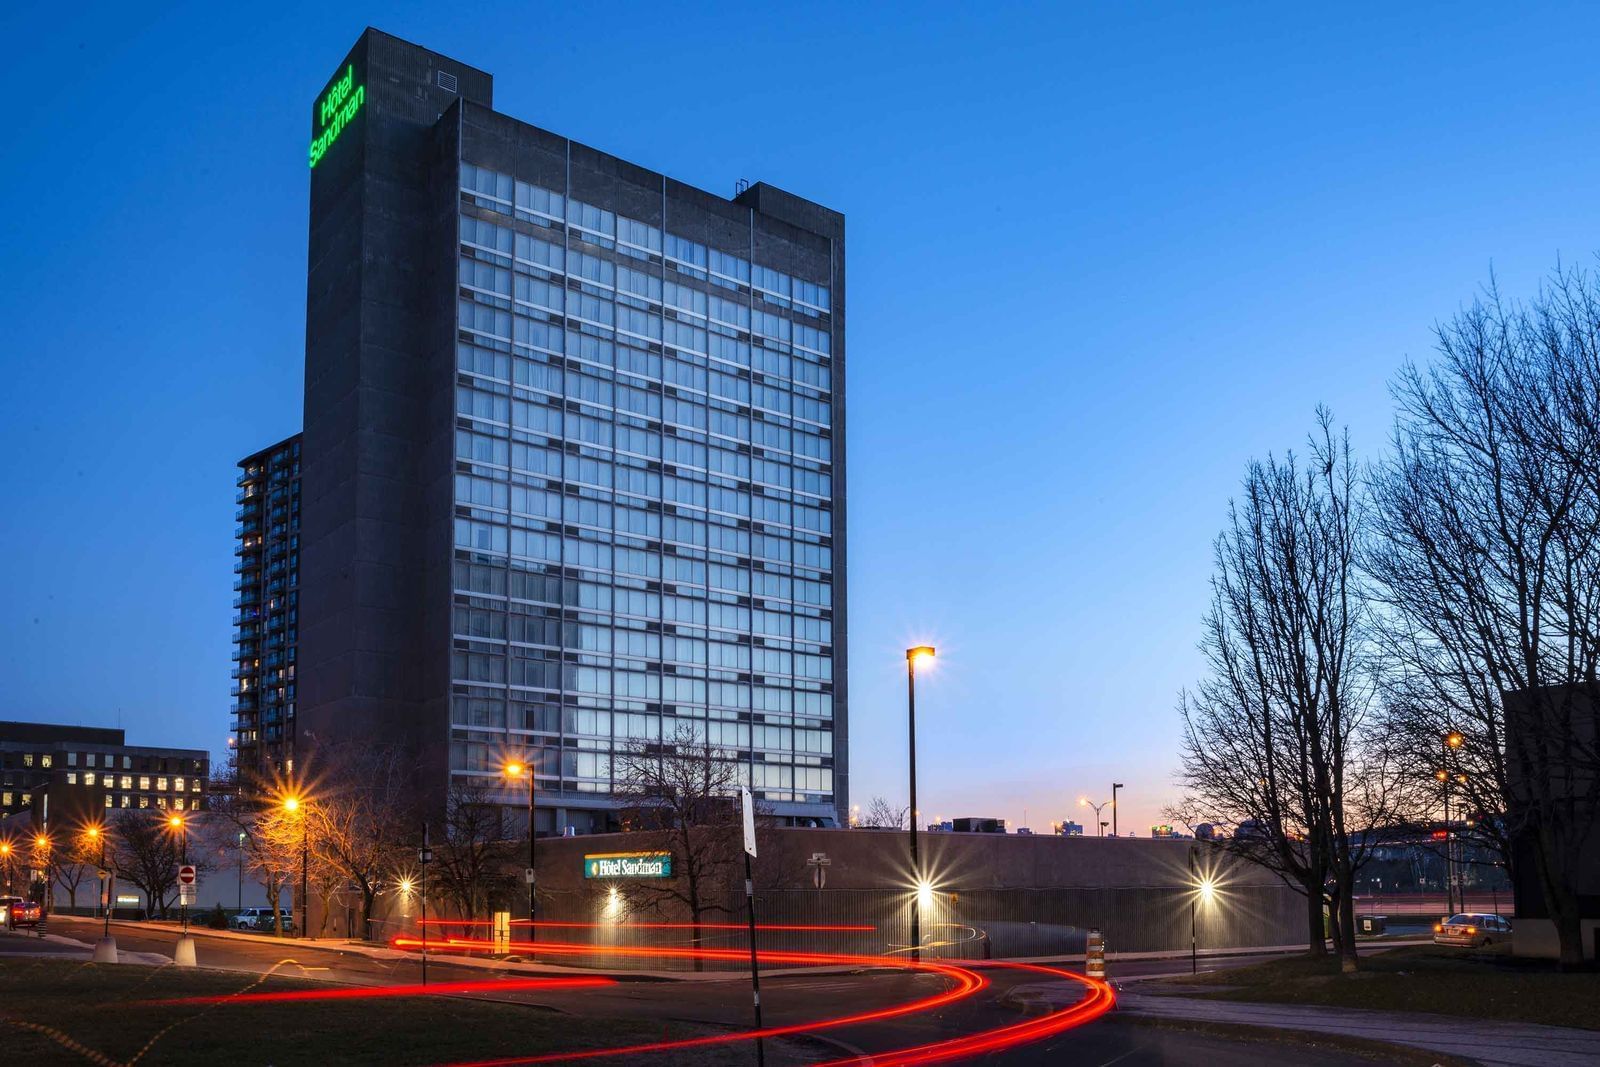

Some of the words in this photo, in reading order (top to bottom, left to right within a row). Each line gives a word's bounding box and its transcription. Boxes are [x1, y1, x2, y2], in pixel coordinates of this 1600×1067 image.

[321, 64, 352, 126] Hôtel
[309, 85, 364, 168] Sandman
[599, 860, 621, 876] Hôtel
[622, 859, 662, 875] Sandman
